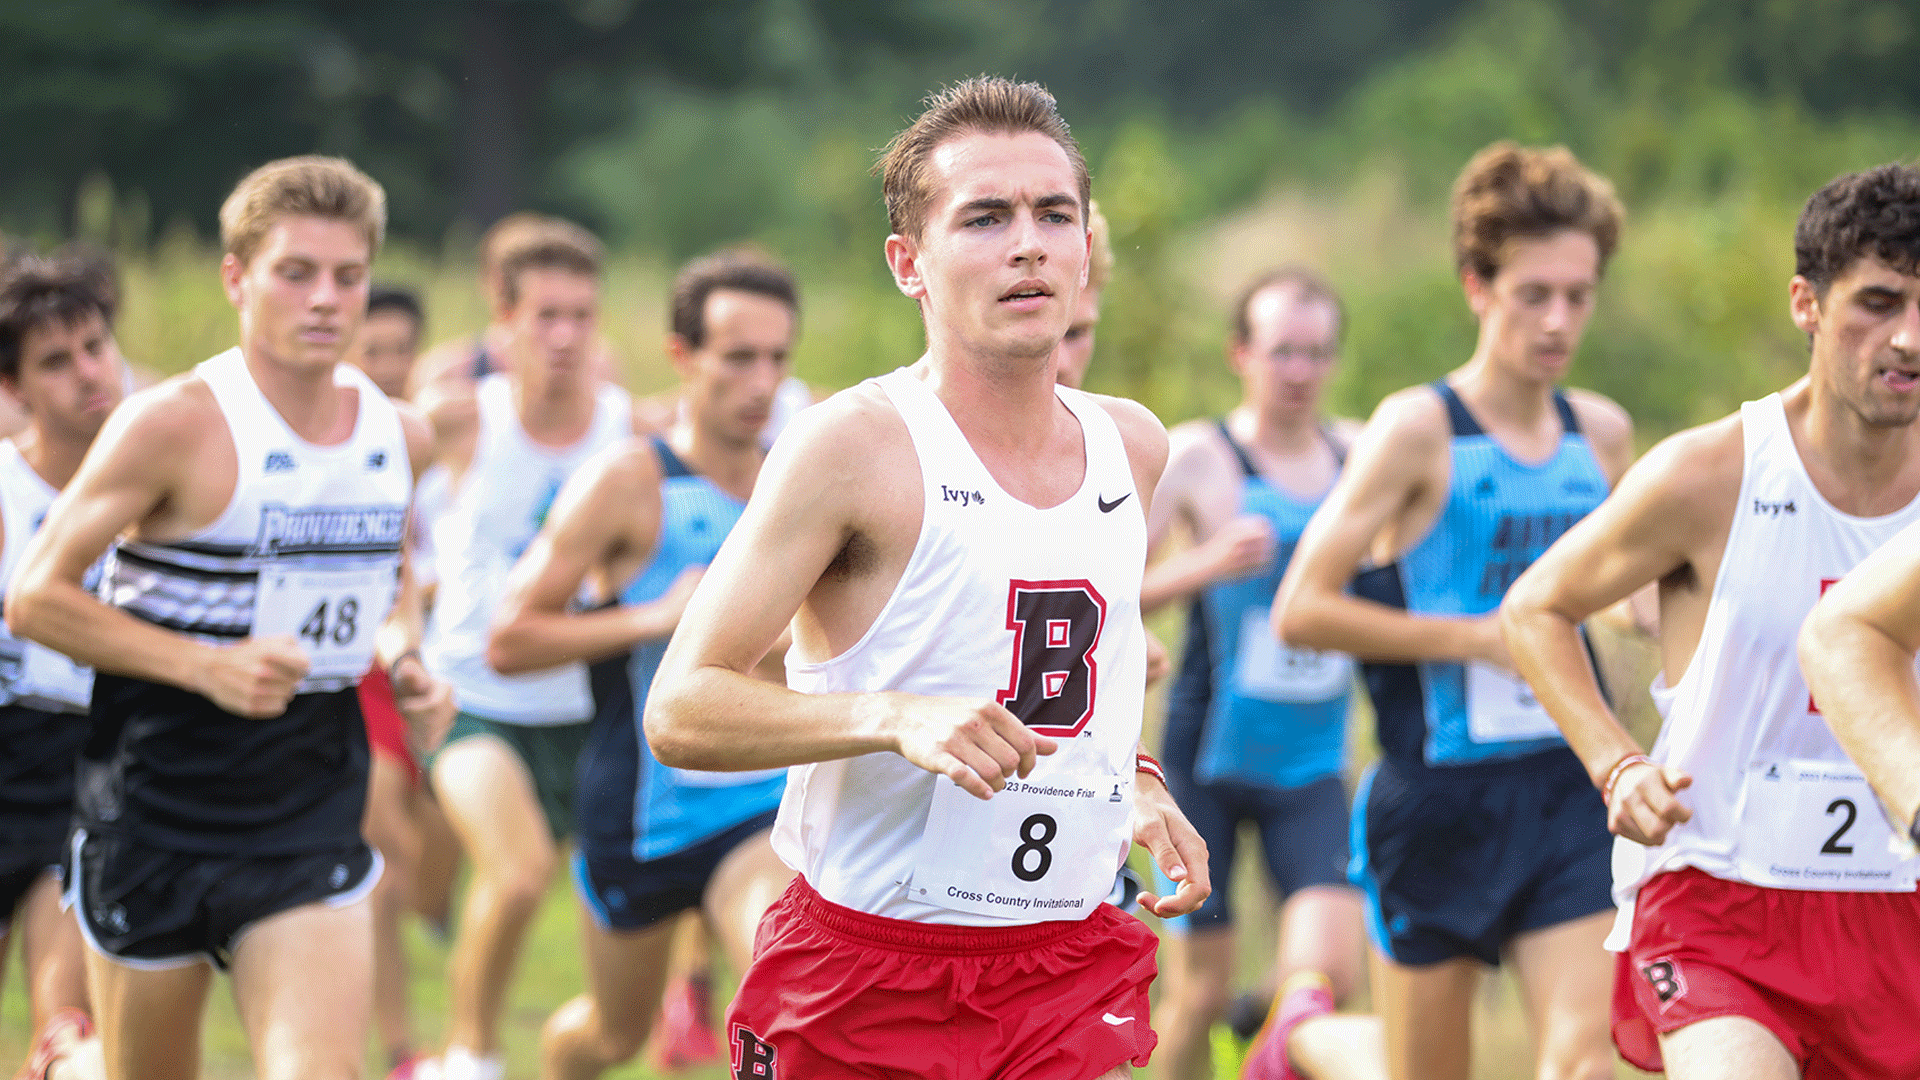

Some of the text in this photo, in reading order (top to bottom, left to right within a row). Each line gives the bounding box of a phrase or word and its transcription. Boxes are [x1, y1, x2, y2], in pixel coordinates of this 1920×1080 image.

[941, 485, 970, 507] Ivy
[1754, 500, 1781, 518] Ivy
[301, 598, 357, 646] 48
[996, 579, 1107, 737] B
[1021, 783, 1075, 798] Providence
[1076, 788, 1095, 798] Friar
[1011, 813, 1057, 882] 8
[1820, 799, 1857, 854] 2
[947, 886, 1084, 910] Cross Country Invitational
[1638, 957, 1686, 1011] B
[731, 1022, 778, 1080] B
